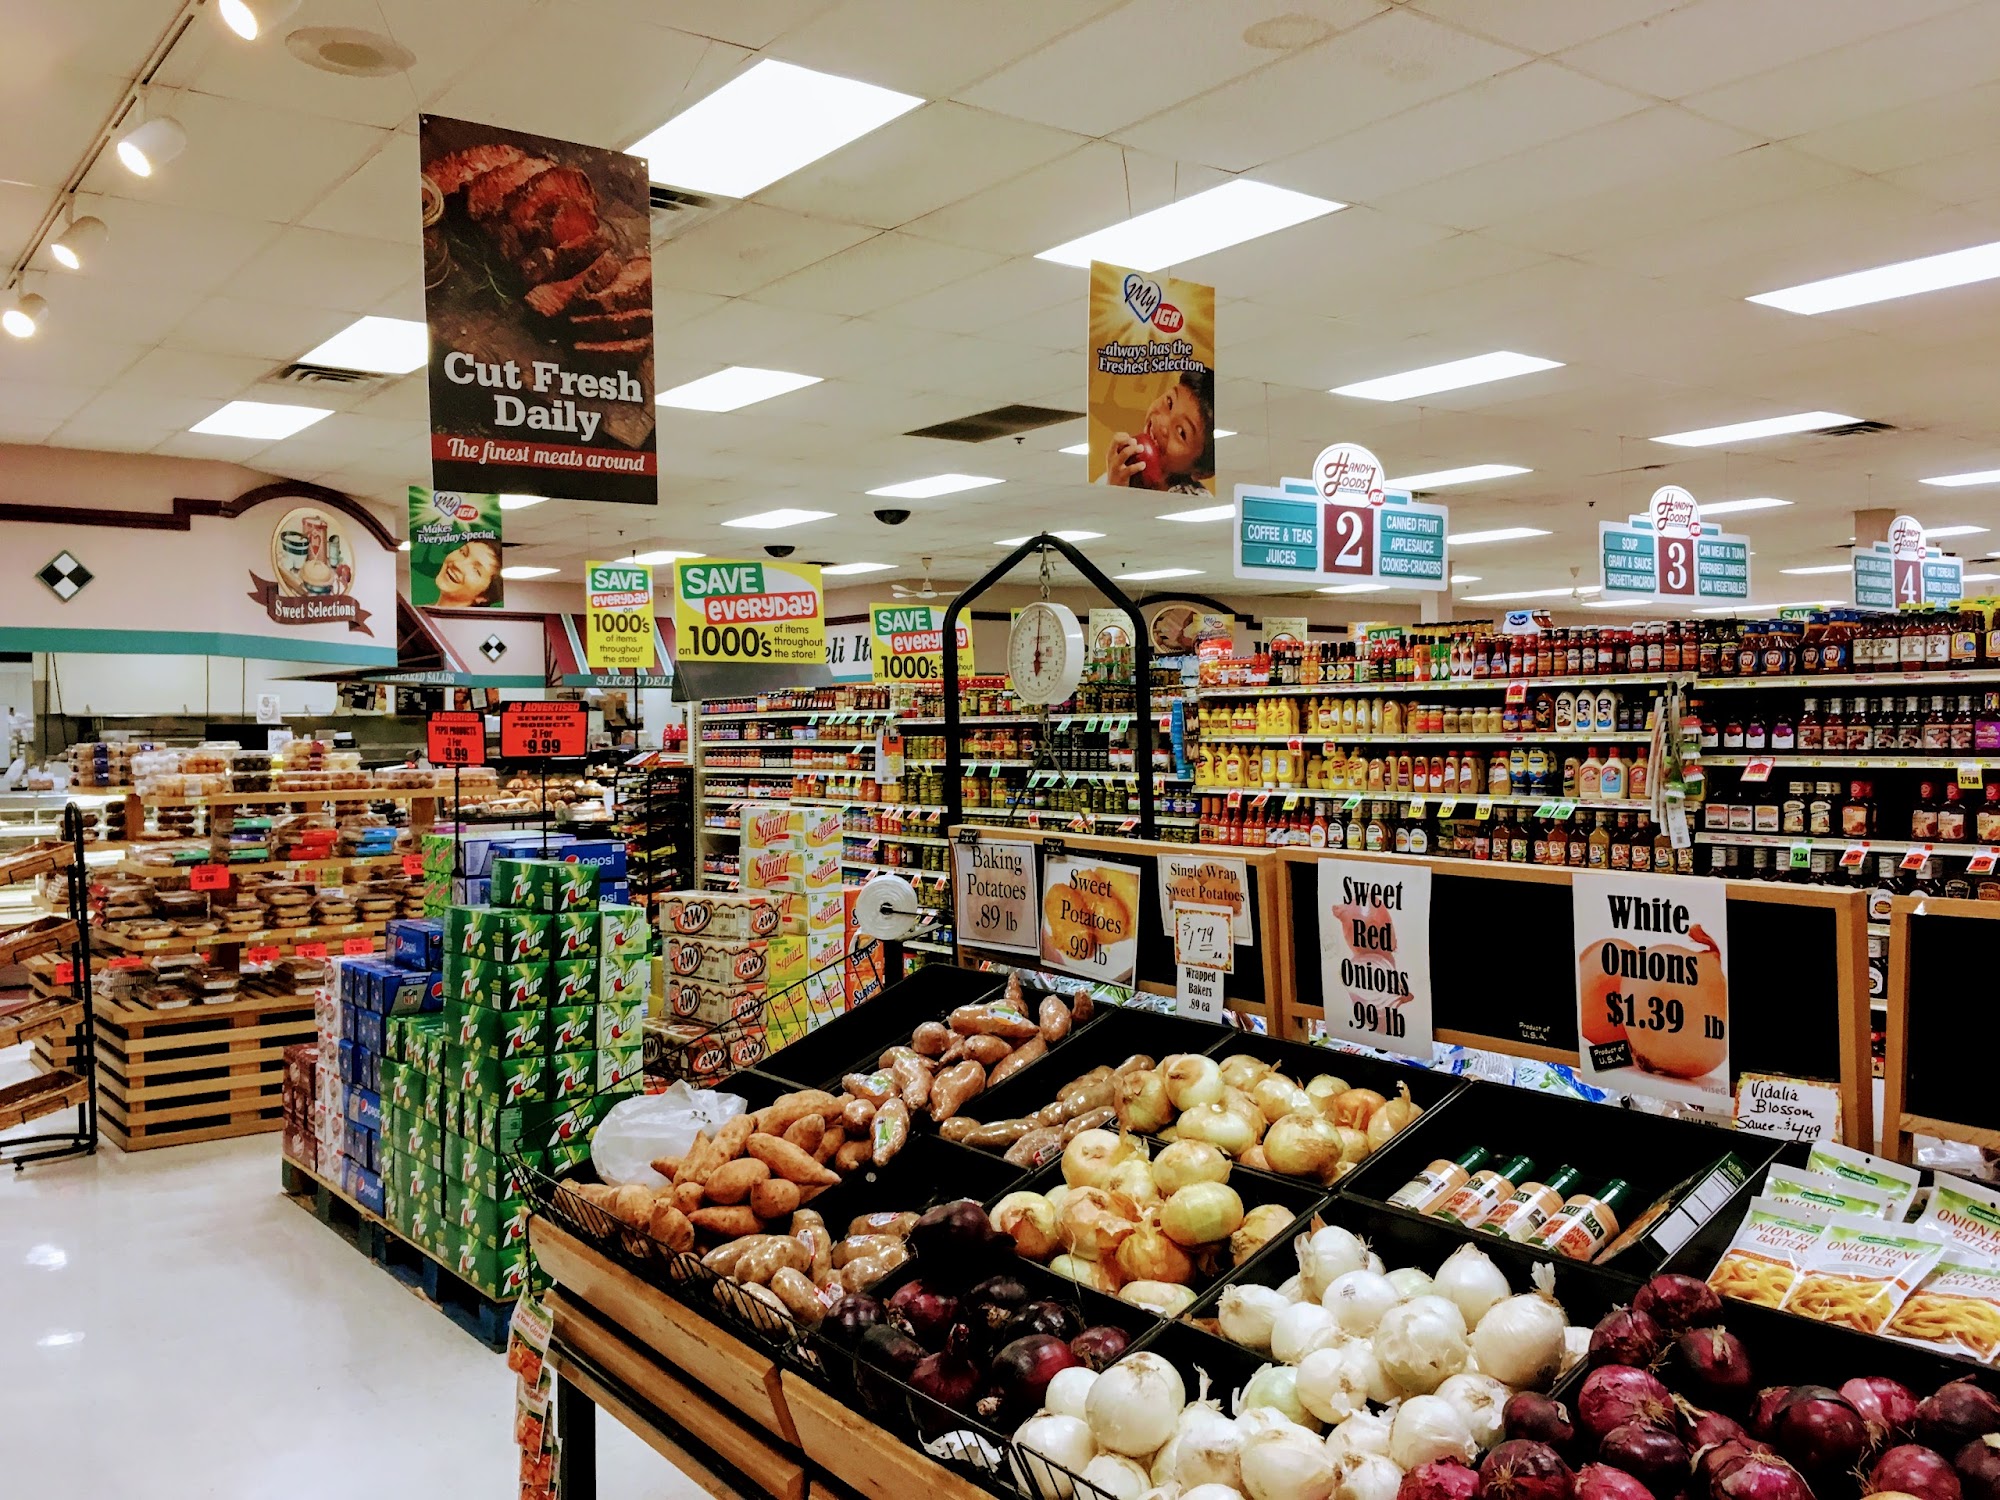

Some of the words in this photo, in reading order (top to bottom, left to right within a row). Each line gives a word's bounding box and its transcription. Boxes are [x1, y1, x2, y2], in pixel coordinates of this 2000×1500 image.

[1125, 283, 1156, 312] My
[1154, 308, 1181, 327] IGA
[1150, 341, 1171, 357] has
[1173, 339, 1192, 356] the
[1099, 357, 1149, 374] Freshest
[1152, 357, 1206, 374] Selection.
[444, 352, 522, 390] Cut
[532, 361, 643, 402] Fresh
[494, 395, 601, 441] Daily
[447, 438, 479, 458] The
[479, 442, 529, 464] finest
[534, 450, 583, 467] meats
[586, 455, 645, 472] around
[435, 495, 457, 512] My
[1370, 492, 1384, 503] IGA
[456, 508, 475, 517] IGA
[1248, 525, 1279, 541] COFFEE
[1283, 529, 1289, 541] &
[1292, 529, 1312, 544] TEAS
[1386, 516, 1417, 531] CANNED
[1418, 519, 1438, 534] FRUIT
[418, 532, 461, 544] Everyday
[461, 531, 496, 540] Special.
[1334, 511, 1363, 567] 2
[1391, 537, 1434, 554] APPLESAUCE
[1622, 538, 1638, 550] SOUP
[1266, 549, 1296, 565] JUICES
[1700, 544, 1710, 556] CAN
[1712, 546, 1725, 557] MEAT
[1726, 547, 1731, 558] &
[1732, 547, 1745, 559] TUNA
[1382, 557, 1441, 575] COOKIES-CRACKERS
[1608, 556, 1626, 568] GRAVY
[1628, 559, 1632, 568] &
[1634, 558, 1652, 570] SAUCE
[1667, 542, 1687, 589] 3
[1700, 561, 1723, 574] PREPARED
[1725, 564, 1745, 576] DINNERS
[594, 570, 644, 590] SAVE
[686, 568, 759, 594] SAVE
[1701, 579, 1712, 590] CAN
[1714, 580, 1746, 593] VEGETABLES
[1901, 565, 1916, 603] 4
[275, 600, 305, 619] Sweet
[308, 601, 355, 618] Selections
[593, 614, 650, 633] 1000's
[774, 625, 783, 633] of
[785, 625, 809, 633] items
[879, 611, 928, 632] SAVE
[600, 646, 643, 654] throughout
[689, 626, 772, 657] 1000's
[774, 637, 823, 648] throughout
[774, 650, 788, 658] the
[792, 650, 816, 658] store!
[881, 656, 938, 678] 1000's
[432, 713, 440, 721] AS
[441, 713, 478, 721] ADVERTISED
[509, 703, 522, 711] AS
[524, 703, 580, 712] ADVERTISED
[532, 729, 537, 738] 3
[540, 729, 553, 738] For
[523, 739, 561, 753] $9.99
[755, 811, 790, 846] Squirt
[755, 853, 789, 886] Squirt
[971, 845, 1022, 875] Baking
[1170, 863, 1202, 880] Single
[1205, 866, 1237, 883] Wrap
[967, 873, 1026, 900] Potatoes
[1070, 869, 1112, 898] Sweet
[1166, 883, 1199, 898] Sweet
[1200, 886, 1245, 902] Potatoes
[1343, 876, 1403, 911] Sweet
[976, 904, 1000, 929] .89
[1006, 911, 1017, 931] lb
[1060, 900, 1121, 934] Potatoes
[1608, 894, 1690, 935] White
[1352, 919, 1393, 951] Red
[1066, 936, 1089, 960] .99
[1093, 944, 1107, 966] lb
[1601, 942, 1698, 986] Onions
[1186, 967, 1216, 982] Wrapped
[1341, 958, 1409, 996] Onions
[1189, 982, 1212, 997] Bakers
[1189, 999, 1200, 1009] .89
[1202, 1002, 1210, 1012] ea
[1606, 991, 1684, 1033] $1.39
[1704, 1015, 1724, 1039] lb
[1349, 1001, 1378, 1032] .99
[1386, 1007, 1405, 1038] lb
[1519, 1022, 1541, 1032] Product
[1594, 1047, 1617, 1057] Product
[1619, 1044, 1625, 1052] of
[1752, 1081, 1799, 1101] Vidalia
[1750, 1099, 1814, 1118] Blossom
[1735, 1115, 1775, 1130] Sauce
[1748, 1223, 1794, 1238] ONION
[1937, 1209, 1990, 1237] ONION
[1756, 1234, 1808, 1253] BATTER
[1827, 1241, 1879, 1256] ONION
[1953, 1229, 2000, 1255] BATTER
[1841, 1252, 1896, 1268] BATTER
